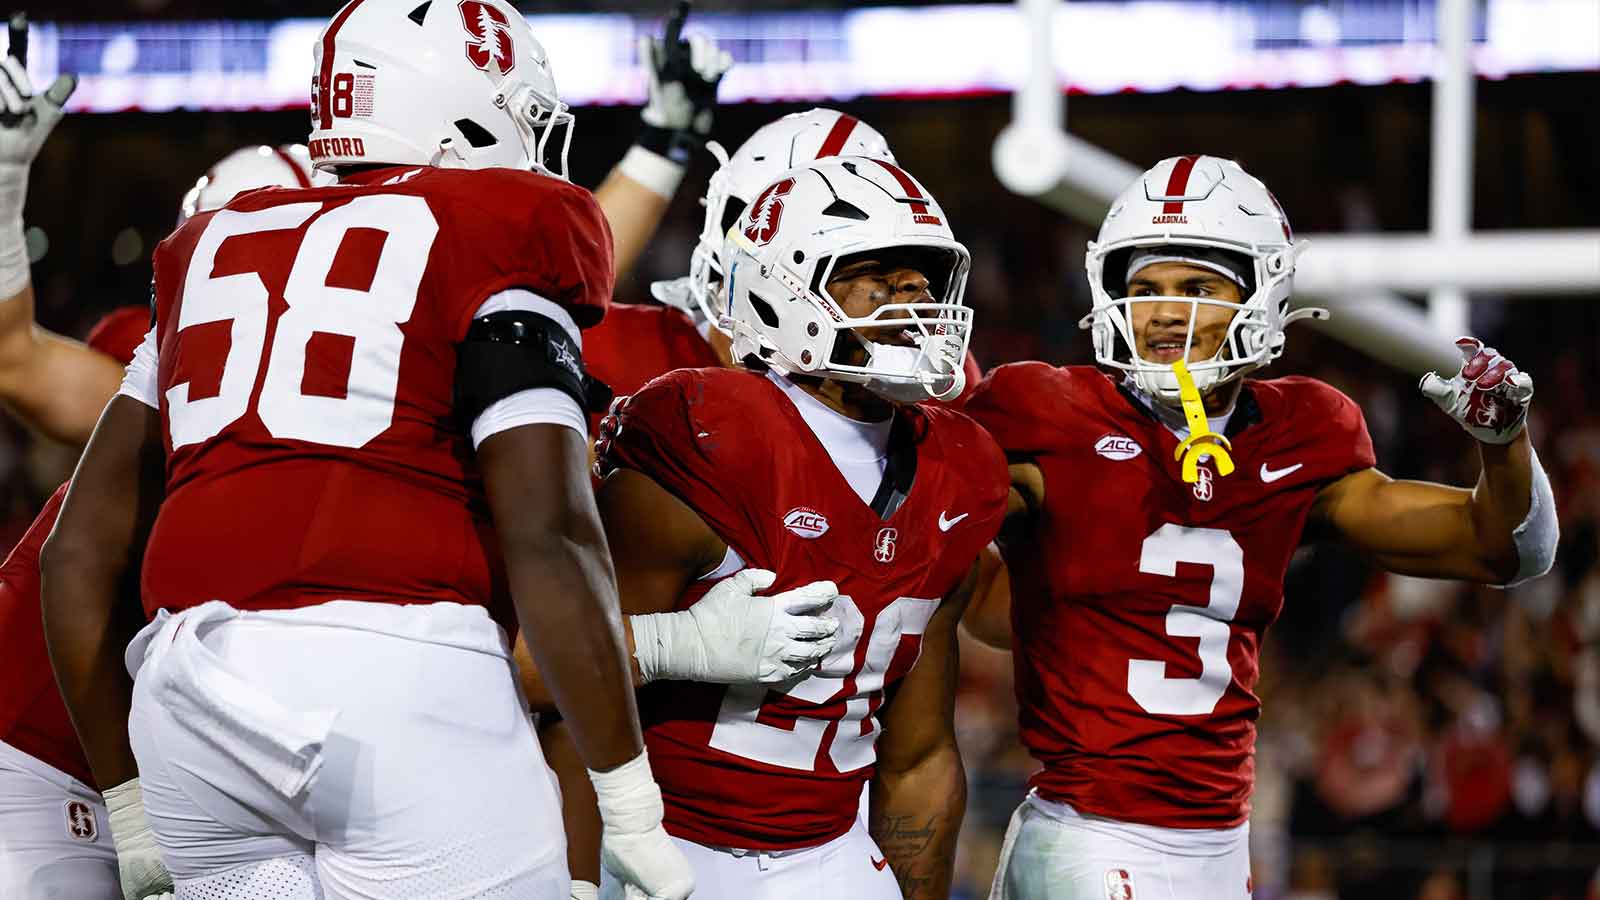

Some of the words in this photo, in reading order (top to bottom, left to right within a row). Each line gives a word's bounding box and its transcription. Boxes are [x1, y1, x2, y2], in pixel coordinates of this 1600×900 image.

[1152, 215, 1189, 225] CARDINAL
[165, 194, 440, 452] 58
[1101, 440, 1136, 451] ACC
[789, 515, 824, 529] ACC
[1127, 522, 1244, 715] 3
[708, 595, 942, 774] 20
